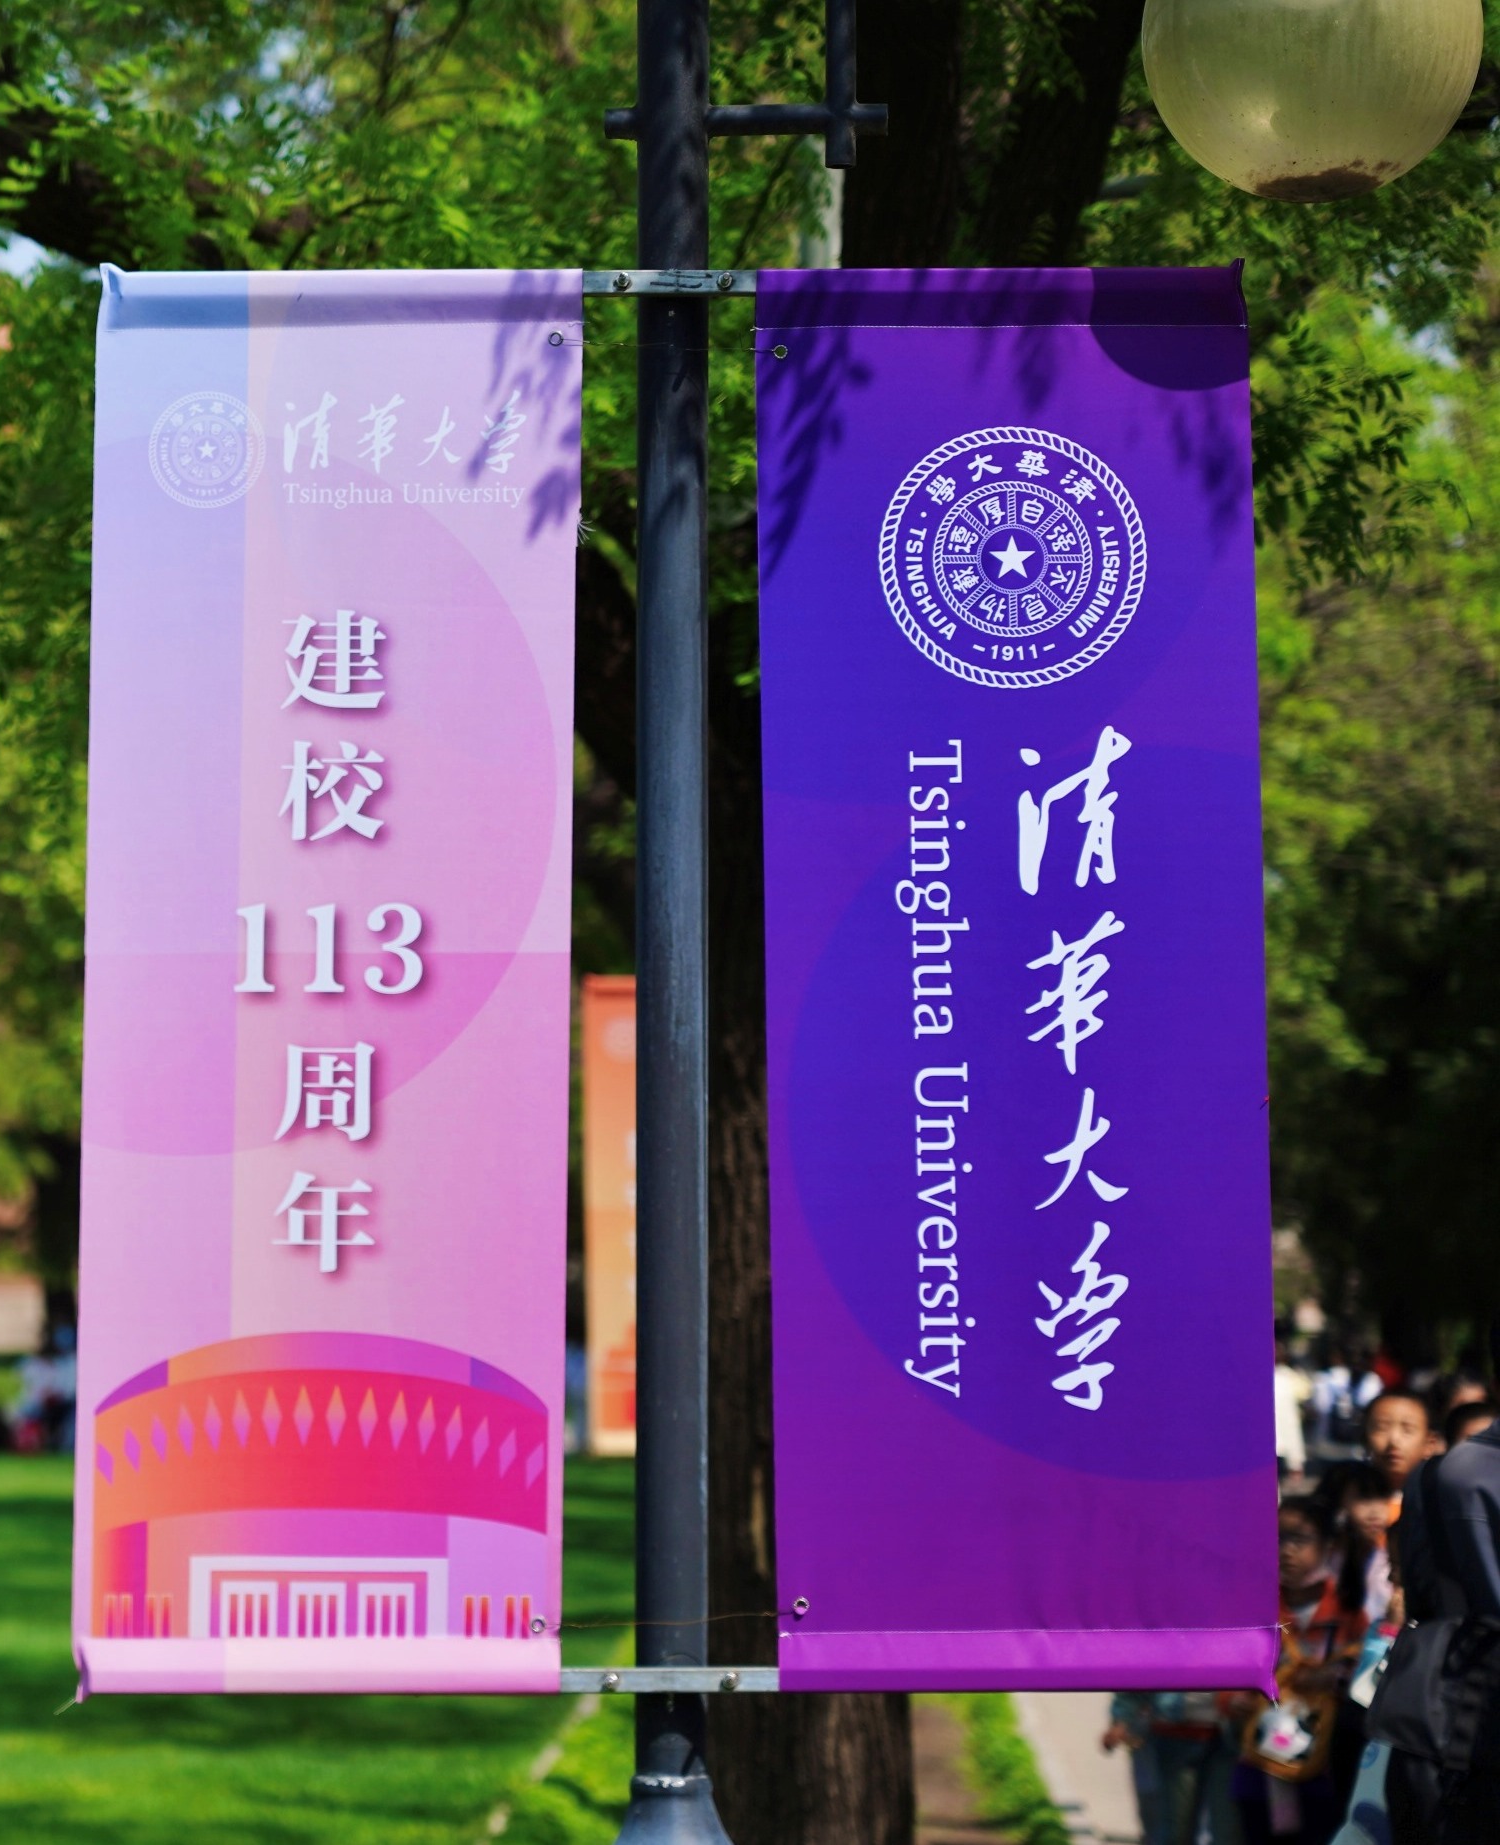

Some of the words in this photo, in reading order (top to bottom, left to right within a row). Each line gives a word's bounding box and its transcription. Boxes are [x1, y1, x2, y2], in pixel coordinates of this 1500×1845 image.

[283, 482, 393, 510] Tsinghua
[402, 482, 526, 509] University
[905, 527, 957, 641] TSINGHUA
[1067, 525, 1121, 638] UNIVERSITY
[895, 739, 970, 1040] Tsinghua
[904, 1061, 976, 1398] University
